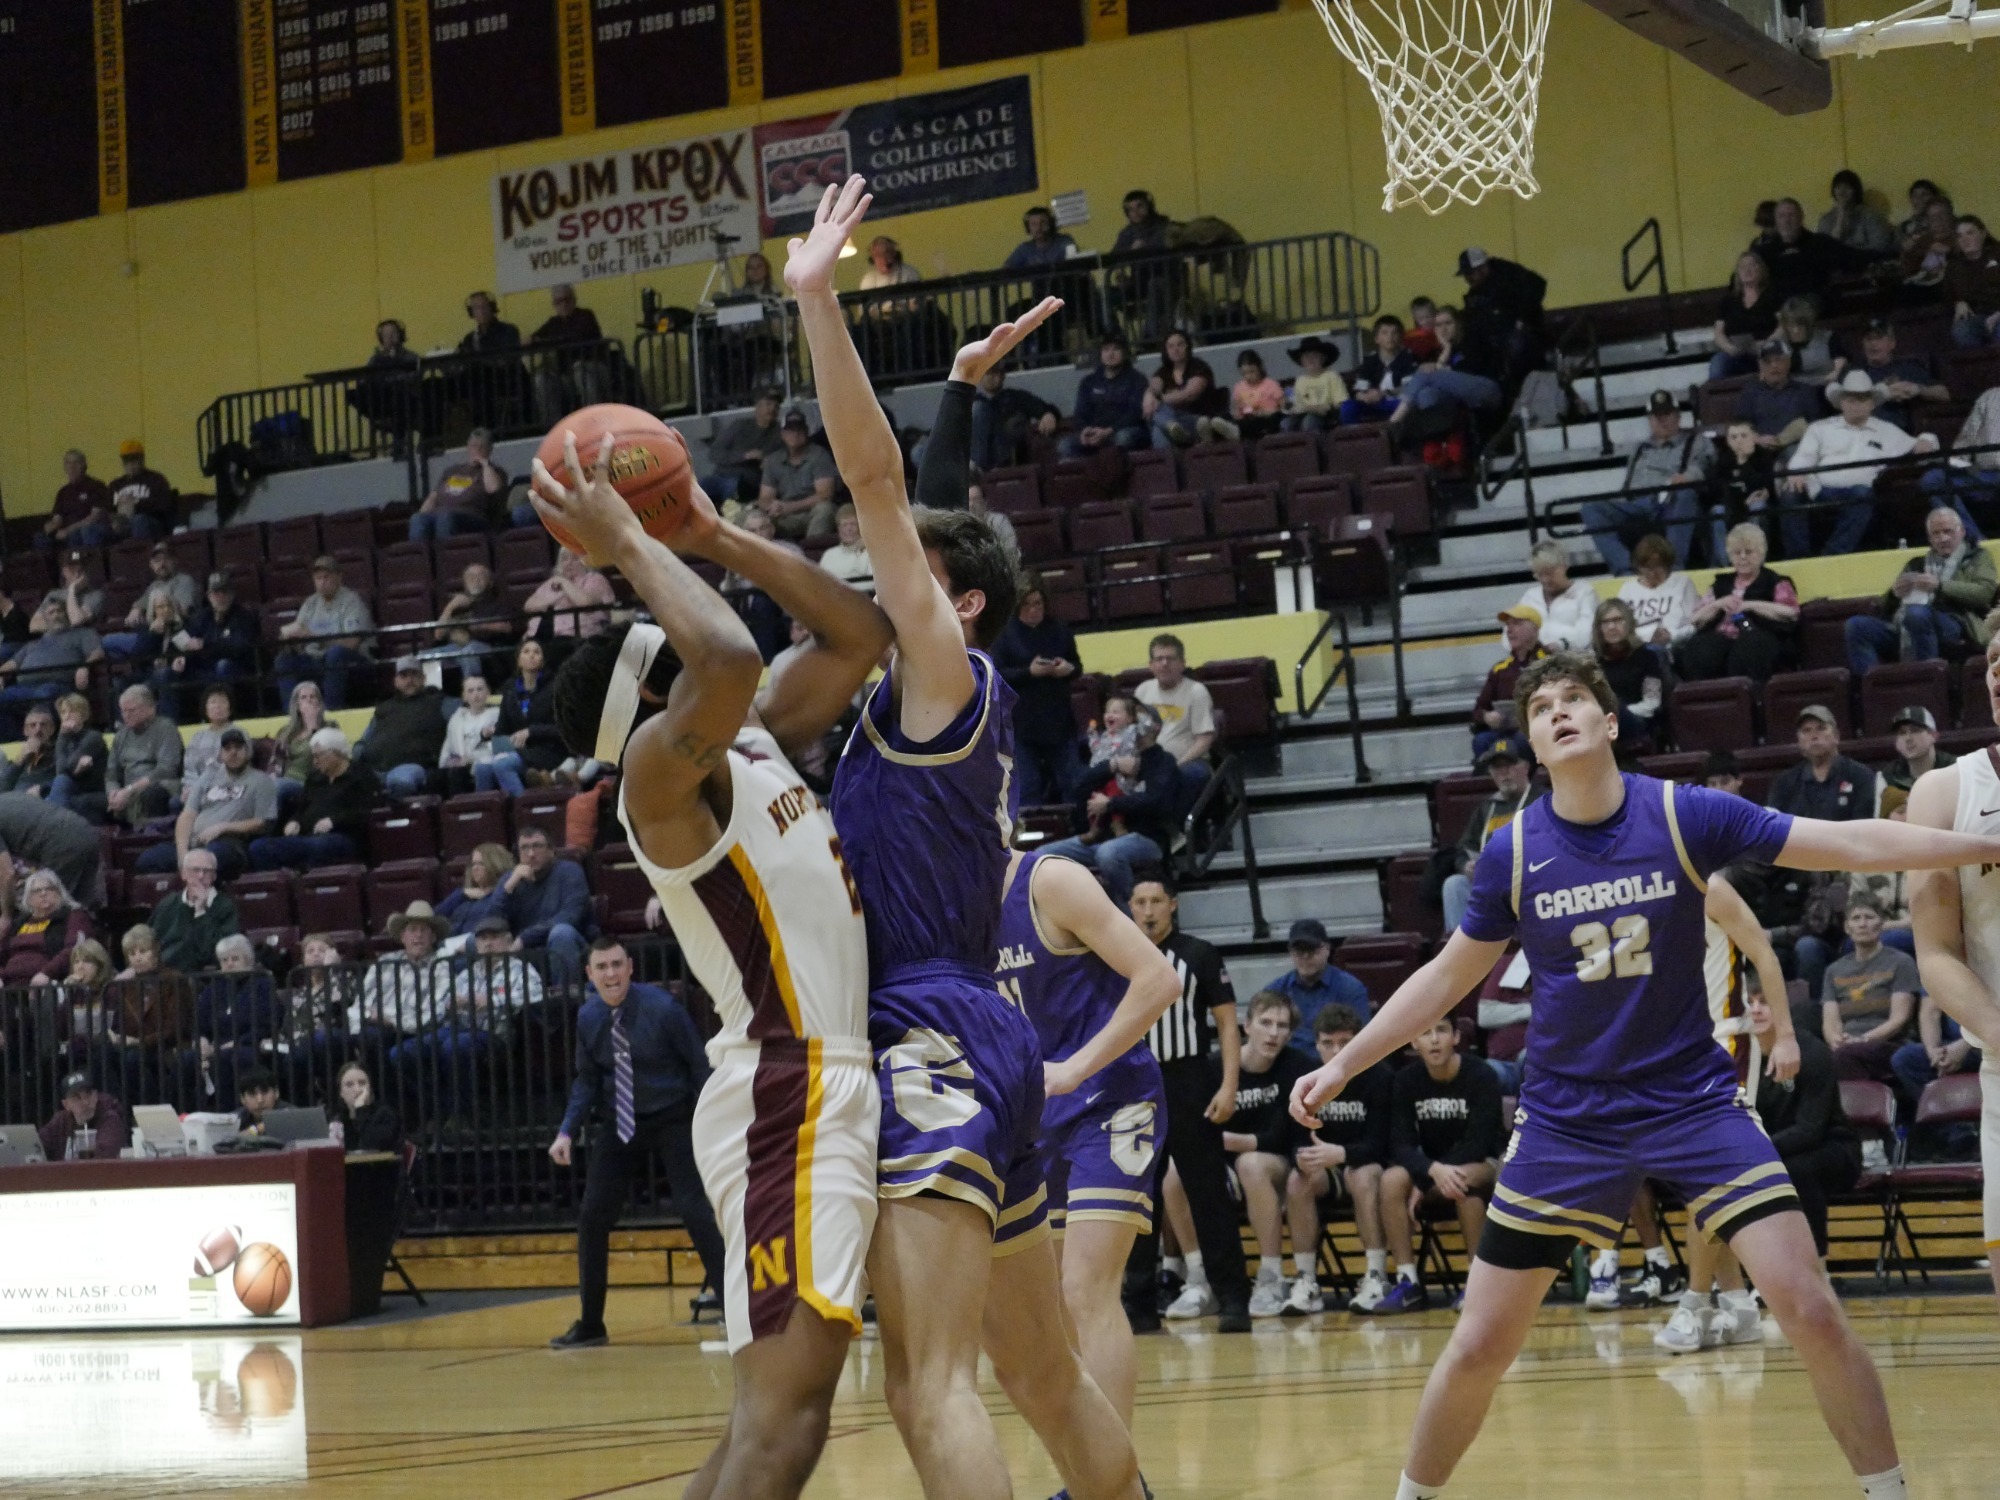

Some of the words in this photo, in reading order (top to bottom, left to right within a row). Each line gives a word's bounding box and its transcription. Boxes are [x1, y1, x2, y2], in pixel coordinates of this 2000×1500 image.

[316, 9, 348, 30] 1997
[598, 19, 632, 42] 1997
[566, 2, 586, 116] CONFERENCE
[282, 80, 313, 100] 2014
[255, 114, 270, 165] NAIA
[282, 110, 314, 131] 2017
[869, 104, 1014, 147] CASCADE
[764, 134, 843, 158] CASCADE
[870, 126, 1016, 169] COLLEGIATE
[500, 157, 618, 240] KOJM
[632, 133, 749, 203] KPQX
[872, 151, 1018, 192] CONFERENCE
[558, 196, 689, 242] SPORTS
[529, 246, 578, 271] VOICE
[588, 240, 608, 261] OF
[619, 234, 647, 257] THE
[582, 258, 625, 278] SINCE
[1534, 870, 1676, 920] CARROLL
[1570, 914, 1653, 982] 32
[748, 1236, 790, 1292] N
[2, 1284, 157, 1299] WWW.NLASF.COM
